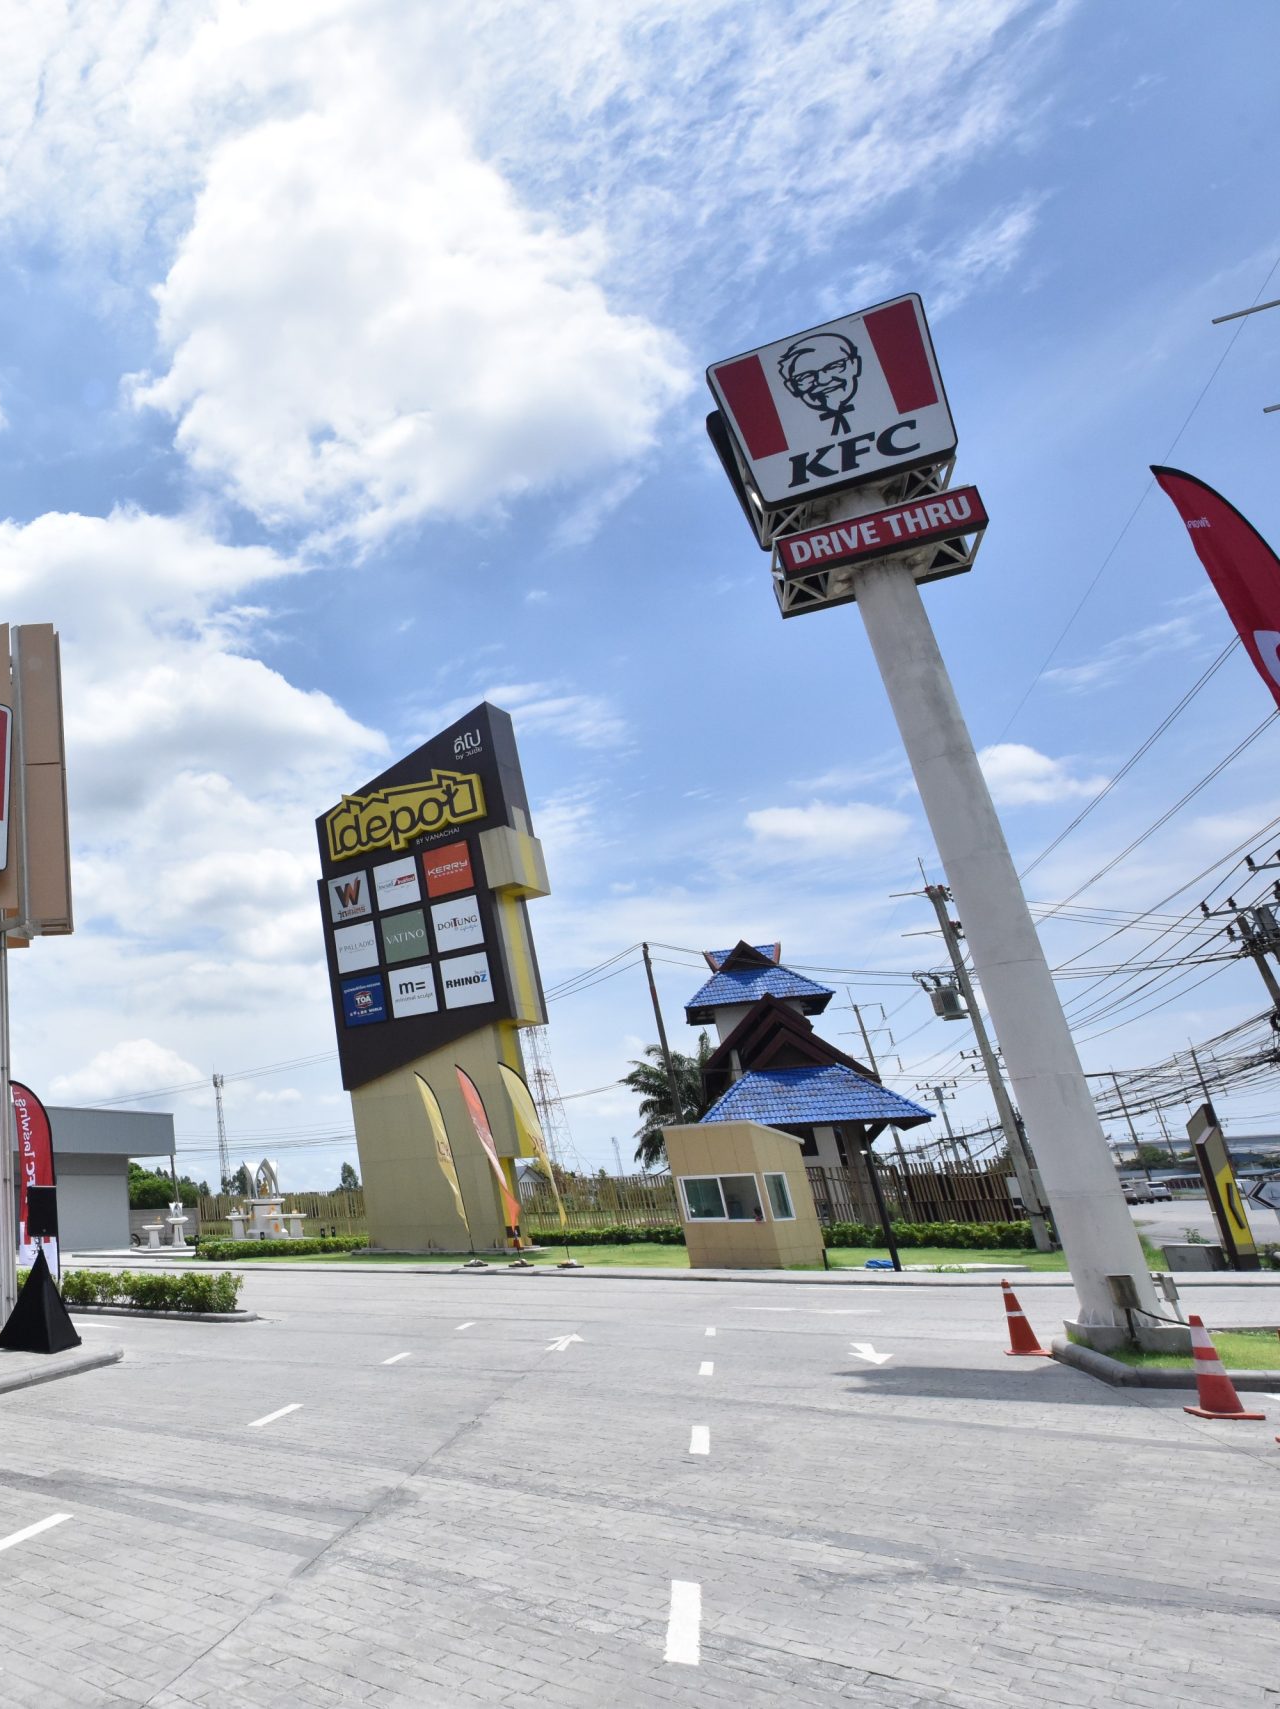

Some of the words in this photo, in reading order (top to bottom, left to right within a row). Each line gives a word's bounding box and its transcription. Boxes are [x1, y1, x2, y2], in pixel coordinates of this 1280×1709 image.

[788, 420, 920, 488] KFC
[789, 520, 880, 564] DRIVE
[882, 495, 971, 538] THRU
[334, 779, 470, 856] depot
[424, 827, 460, 843] VANACHAI
[427, 859, 468, 876] KERRY
[386, 929, 424, 945] VATINO
[446, 973, 488, 989] RHINOZ
[355, 995, 372, 1005] TOA
